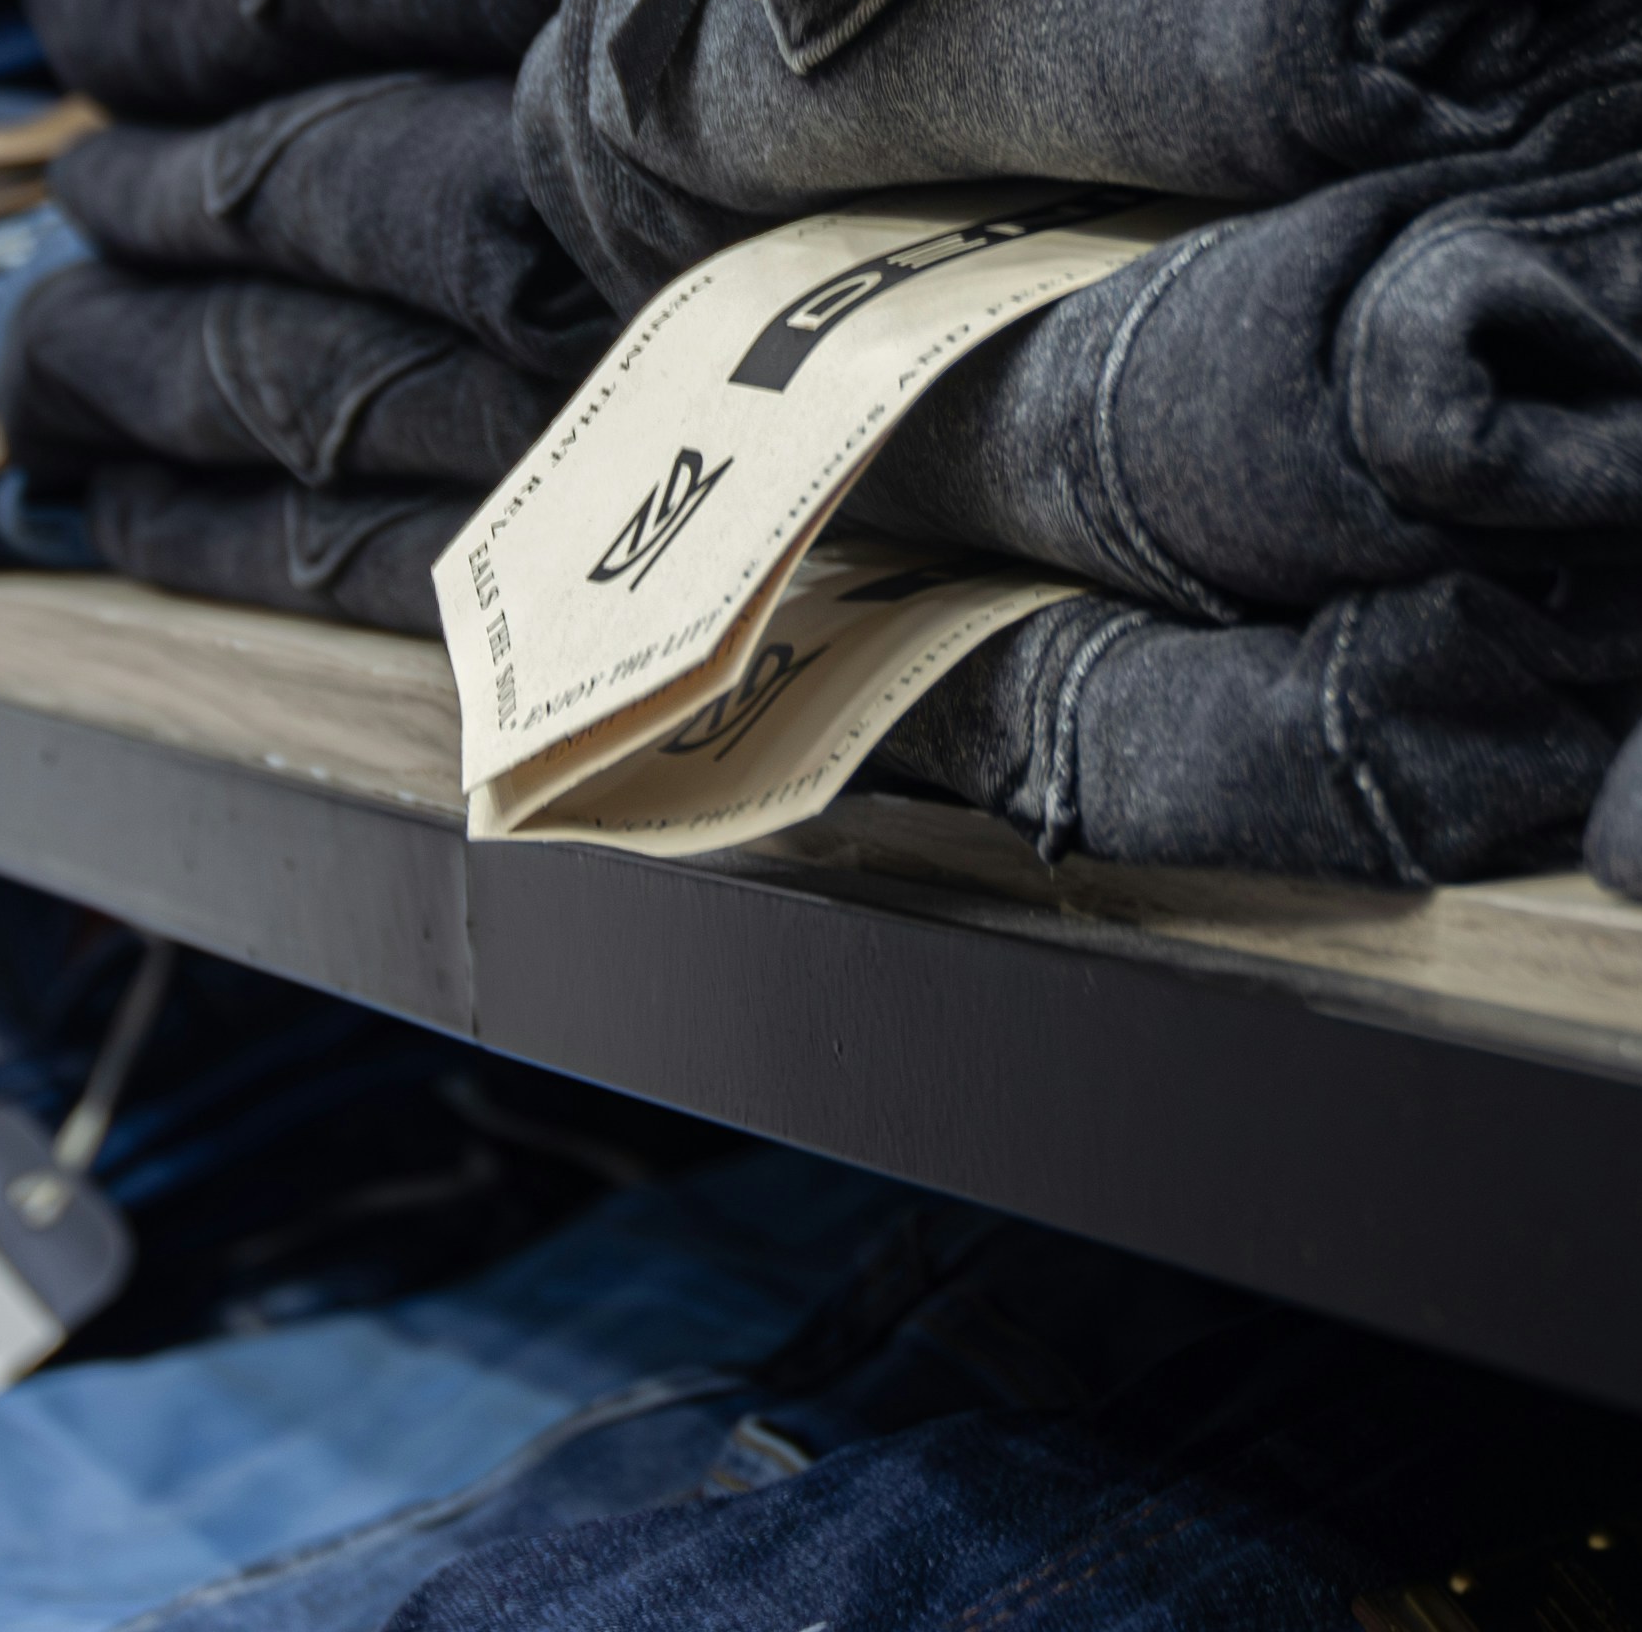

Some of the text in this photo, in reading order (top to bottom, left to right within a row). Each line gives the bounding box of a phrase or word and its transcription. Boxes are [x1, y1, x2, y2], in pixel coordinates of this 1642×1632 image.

[899, 324, 970, 391] AND
[551, 382, 617, 468] THAT
[486, 608, 511, 666] THE
